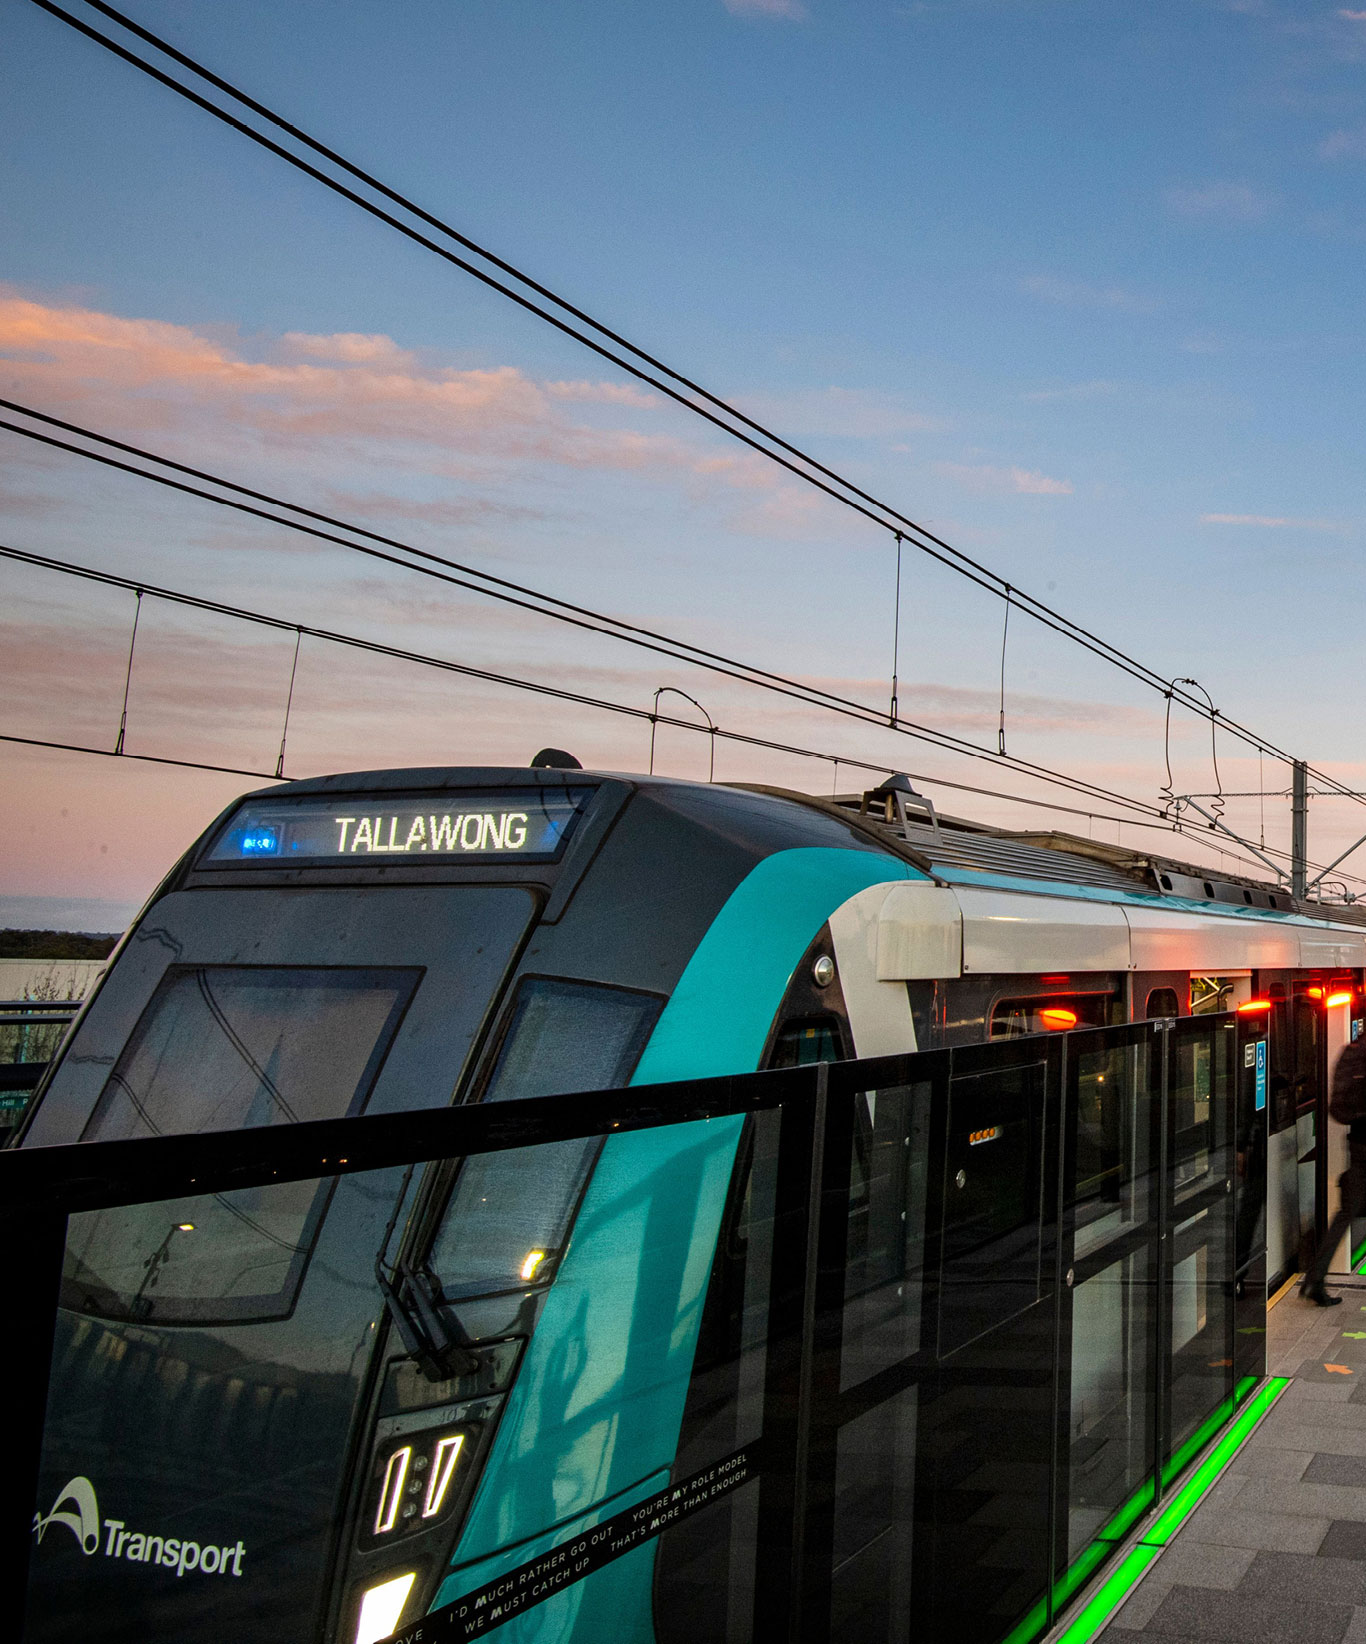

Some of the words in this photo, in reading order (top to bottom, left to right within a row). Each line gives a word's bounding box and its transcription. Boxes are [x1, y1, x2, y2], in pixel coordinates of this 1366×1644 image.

[335, 813, 528, 852] TALLAWONG
[611, 1525, 646, 1552] THAT'S
[650, 1506, 680, 1530] MORE
[684, 1490, 708, 1510] THAN
[711, 1468, 747, 1495] ENOUGH
[633, 1496, 669, 1521] YOU'RE
[672, 1485, 688, 1501] MY
[691, 1470, 715, 1490] ROLE
[718, 1454, 747, 1475] MODEL
[104, 1519, 246, 1577] Transport
[450, 1606, 468, 1622] I'D
[474, 1580, 514, 1609] MUCH
[519, 1552, 566, 1584] RATHER
[570, 1541, 587, 1556] GO
[591, 1526, 613, 1545] OUT
[464, 1615, 484, 1634] WE
[490, 1592, 527, 1620] MUST
[532, 1568, 570, 1596] CATCH
[575, 1557, 590, 1572] UP
